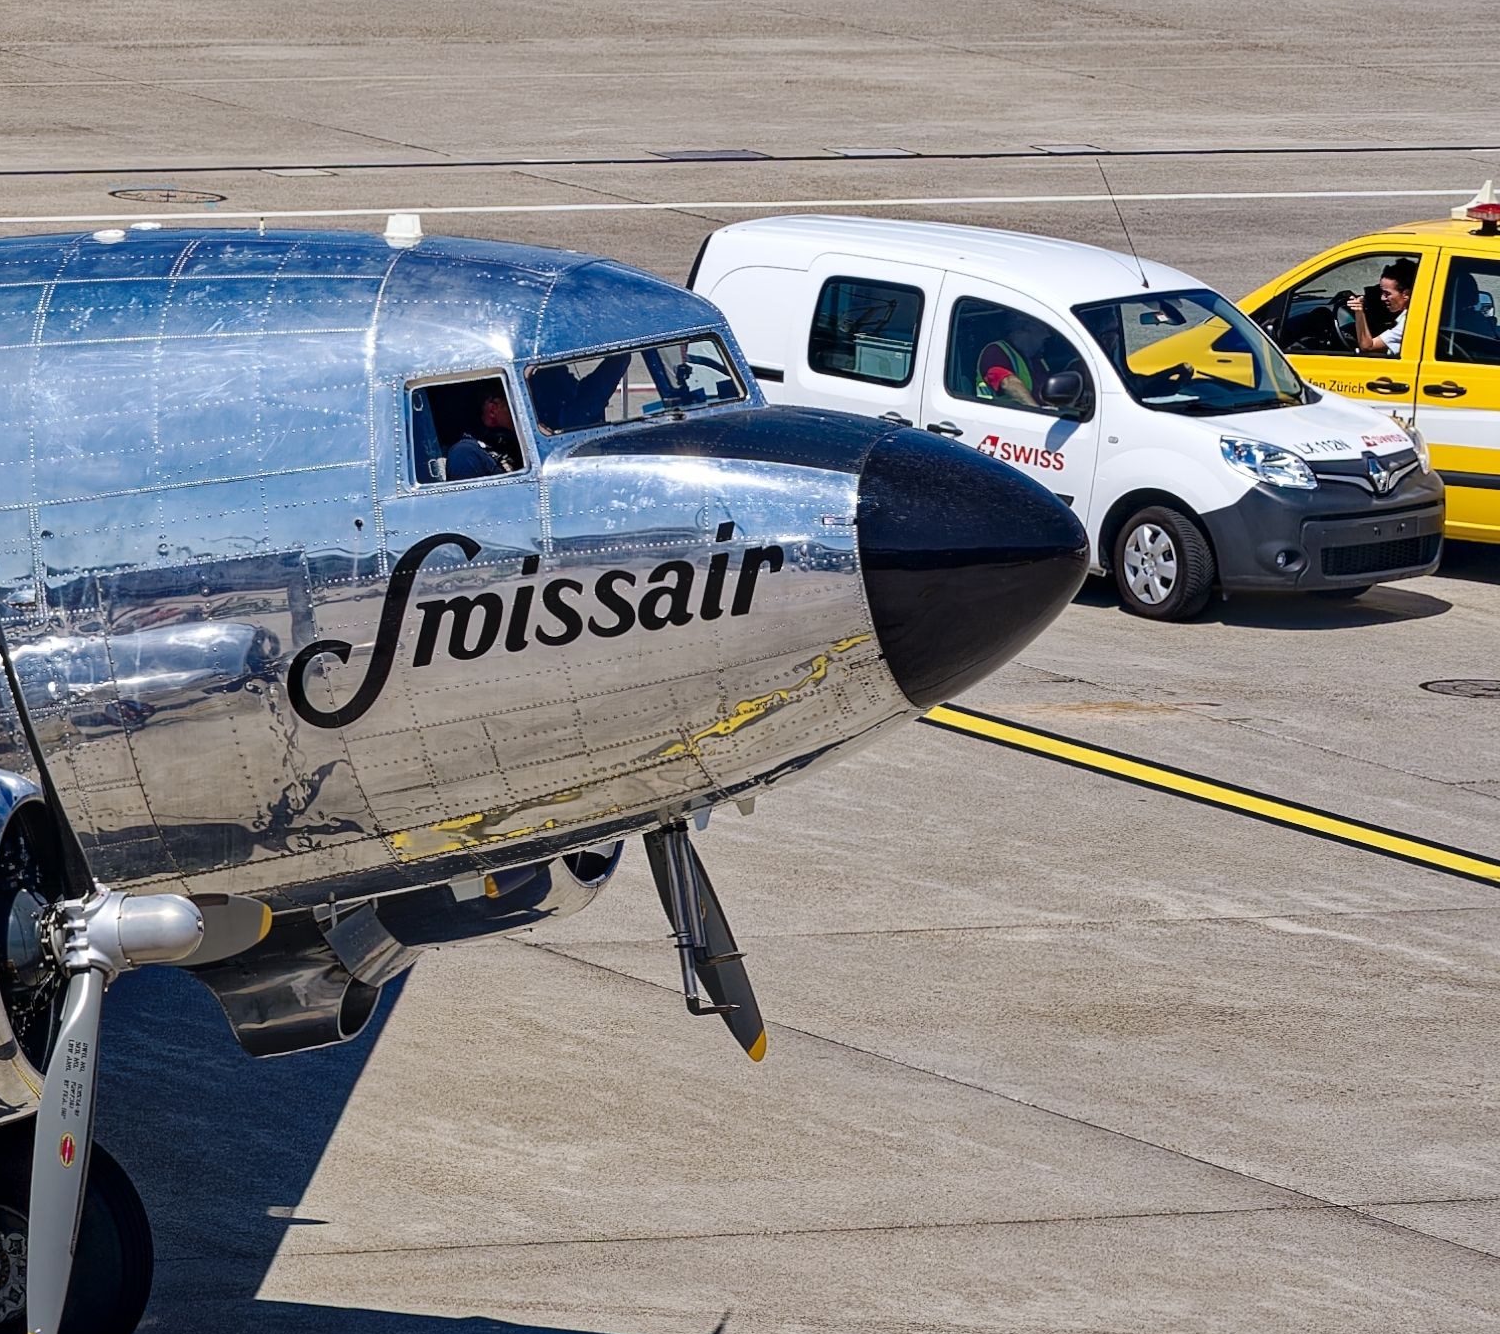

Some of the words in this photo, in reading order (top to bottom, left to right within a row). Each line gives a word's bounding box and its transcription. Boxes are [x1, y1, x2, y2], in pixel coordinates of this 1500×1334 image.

[1329, 379, 1365, 394] Zürich
[1000, 442, 1065, 471] SWISS
[1294, 441, 1316, 455] LX
[286, 520, 785, 729] Swissair
